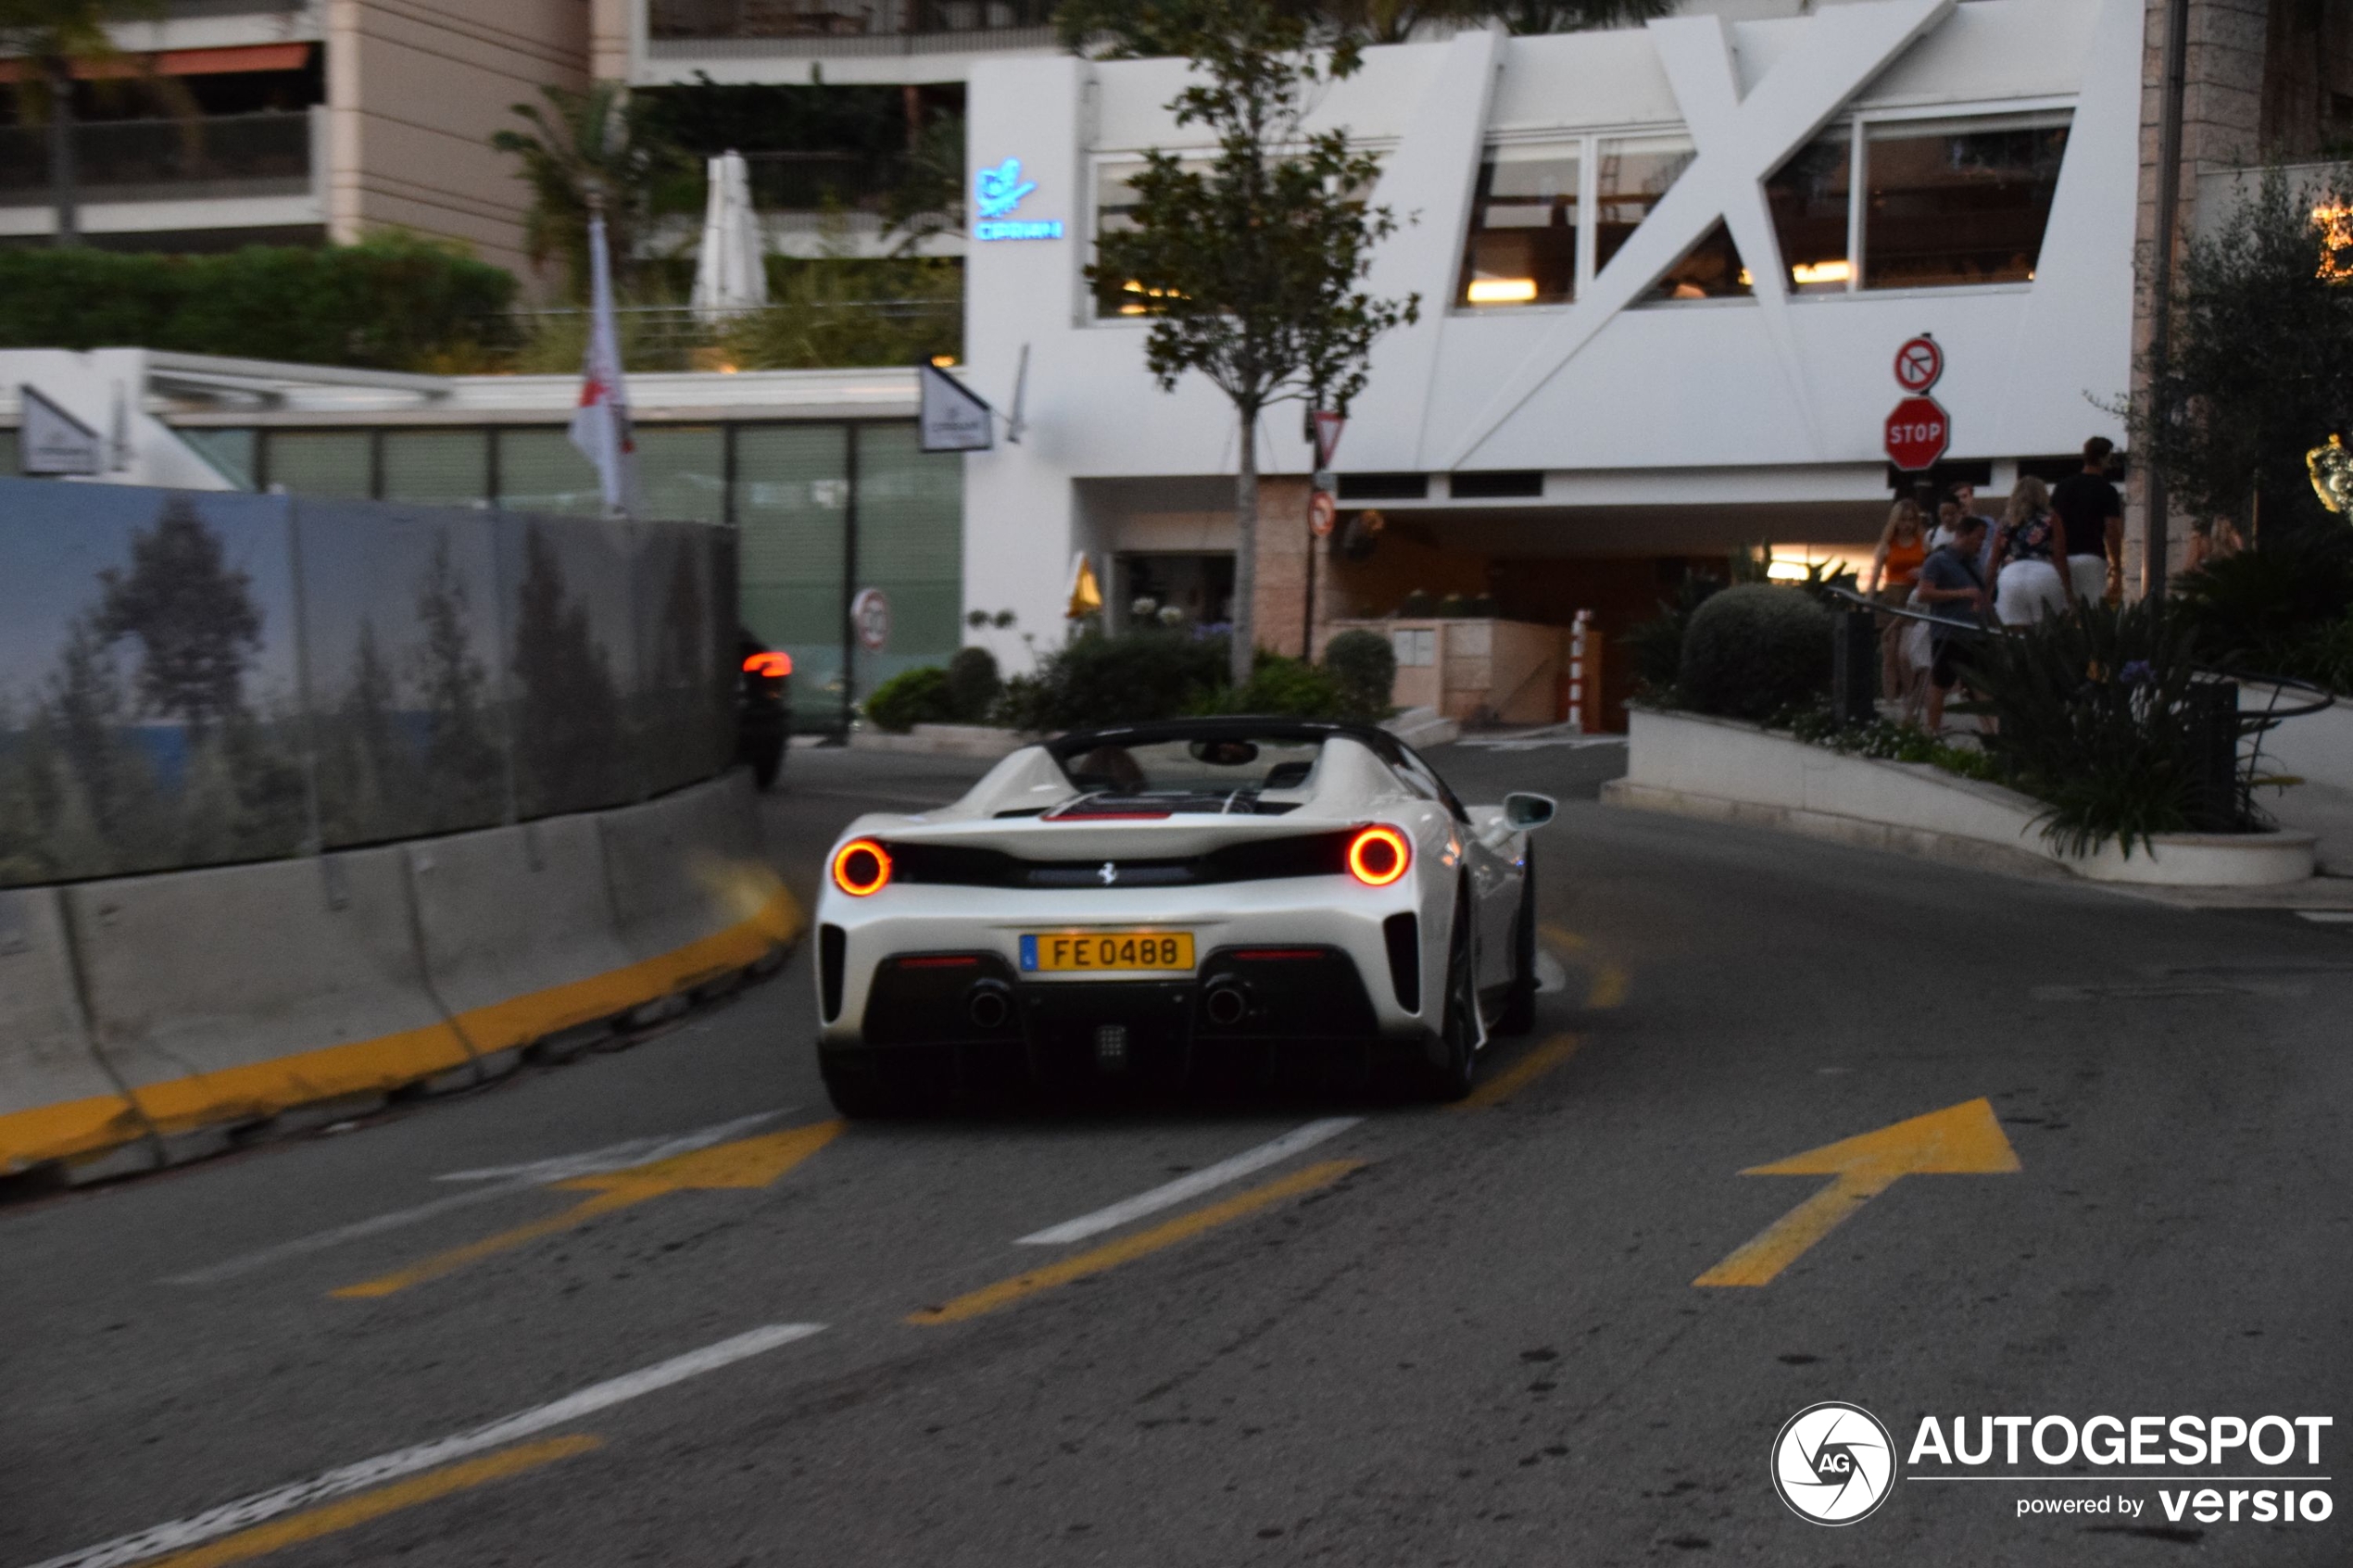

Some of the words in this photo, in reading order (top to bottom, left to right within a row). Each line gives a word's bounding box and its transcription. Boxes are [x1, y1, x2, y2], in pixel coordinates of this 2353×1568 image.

[1890, 422, 1942, 445] STOP
[1053, 939, 1090, 966] FE
[1100, 938, 1178, 965] 0488
